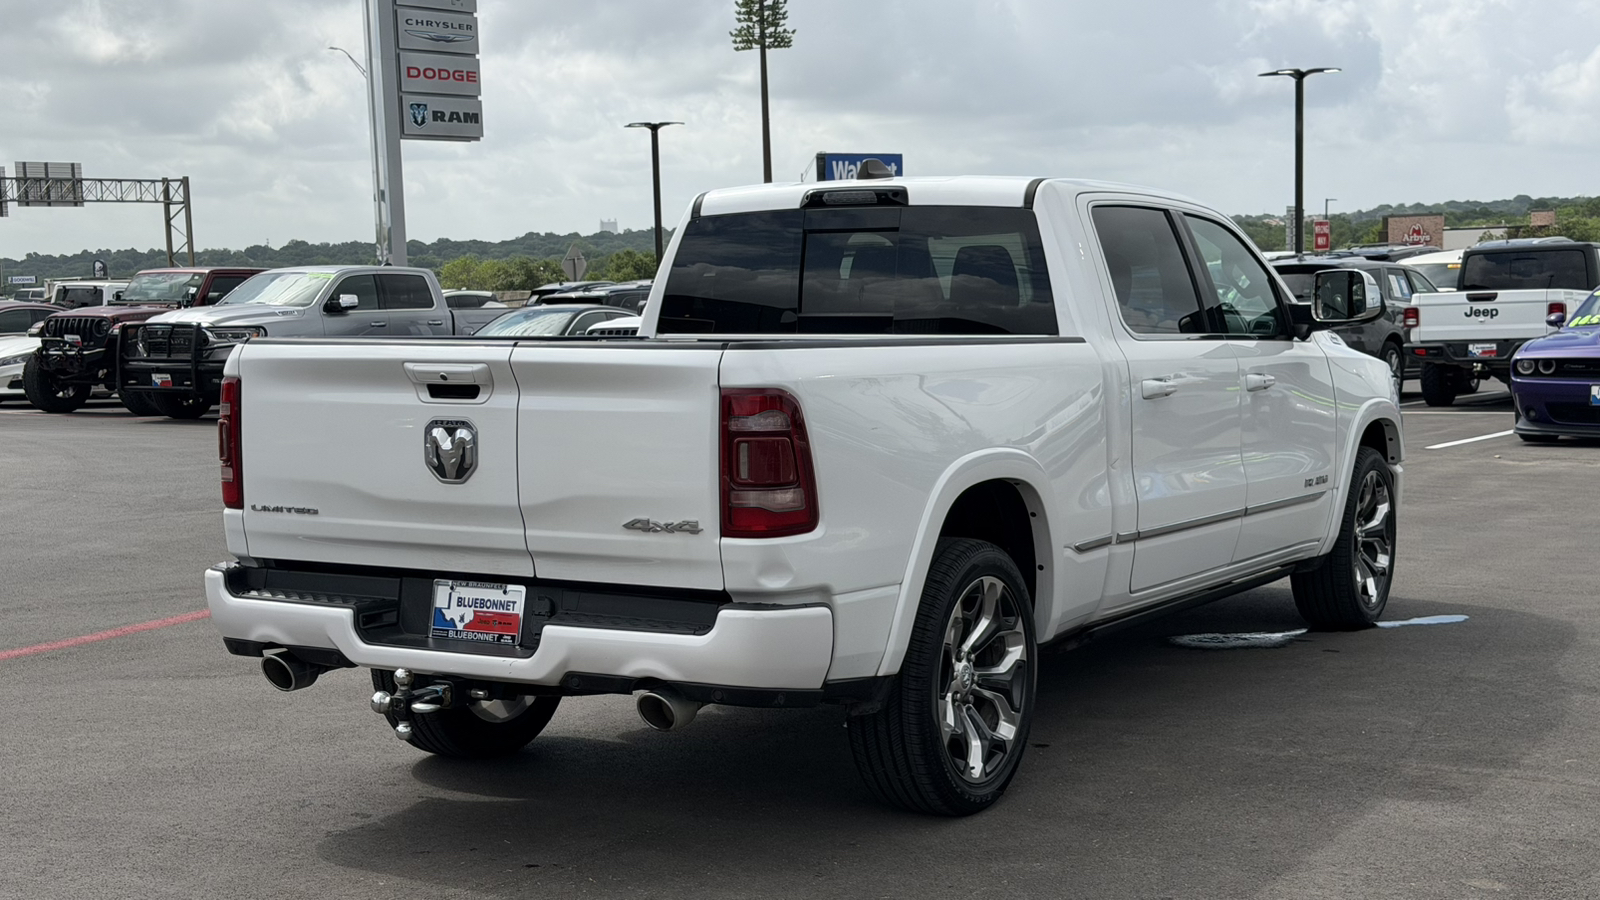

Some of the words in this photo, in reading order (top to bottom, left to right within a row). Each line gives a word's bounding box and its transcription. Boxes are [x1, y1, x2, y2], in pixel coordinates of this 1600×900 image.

[405, 18, 473, 31] CHRYSLER
[406, 66, 477, 83] DODGE
[432, 110, 479, 124] RAM
[1403, 232, 1430, 243] Arby's
[1464, 306, 1499, 319] Jeep
[250, 504, 319, 515] LIMITED
[622, 518, 704, 535] 4x4
[468, 582, 506, 590] BRAUNFELS
[456, 597, 517, 611] BLUEBONNET
[448, 630, 499, 642] BLUEBONNET
